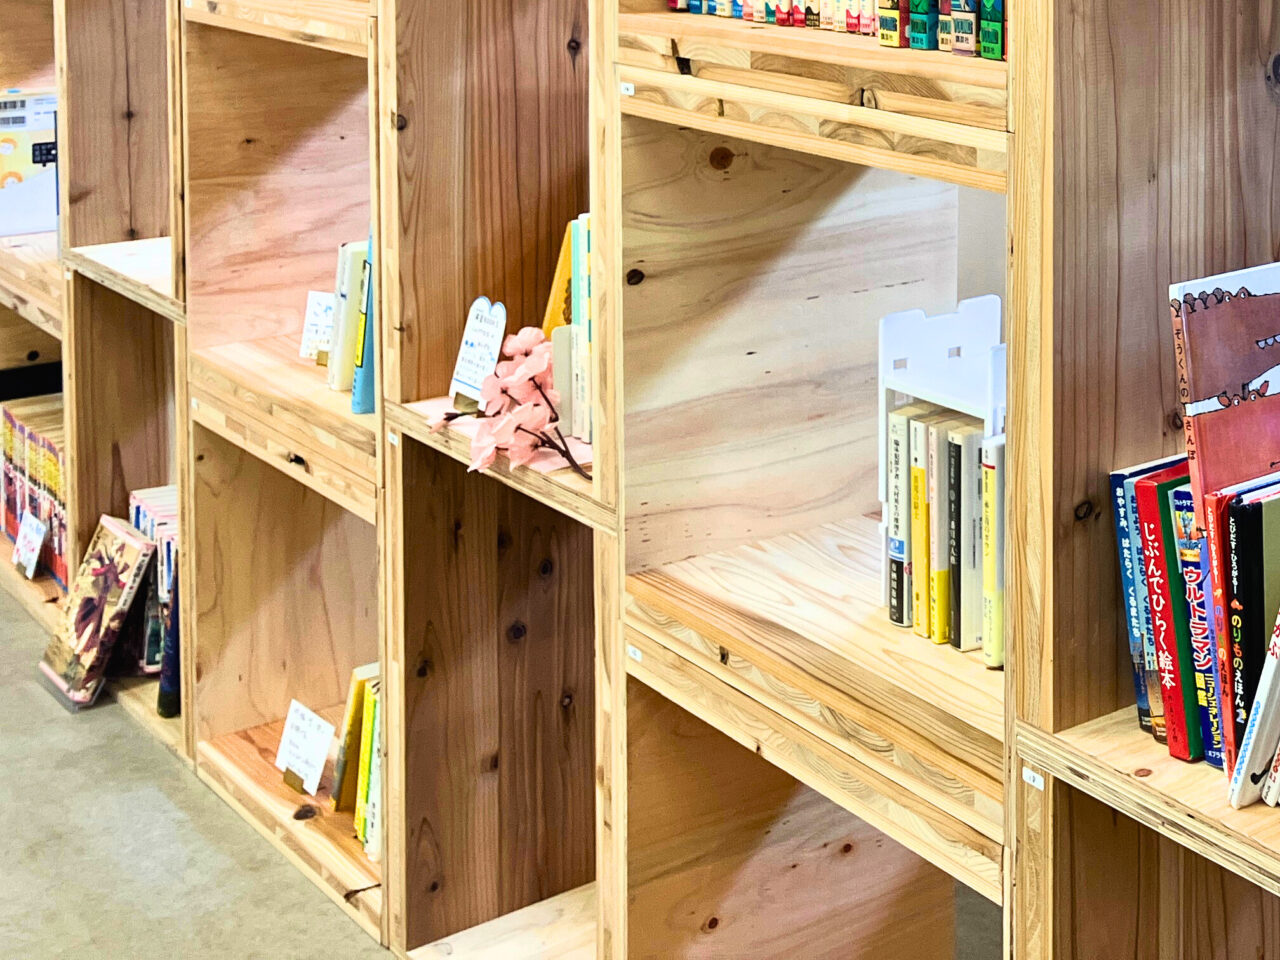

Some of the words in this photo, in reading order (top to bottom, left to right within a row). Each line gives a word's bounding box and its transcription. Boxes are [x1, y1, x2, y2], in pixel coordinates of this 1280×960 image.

[1142, 521, 1177, 691] じぶんでひらく絵本
[1183, 566, 1214, 672] ウルトラマン
[1231, 613, 1247, 709] のりものえほん
